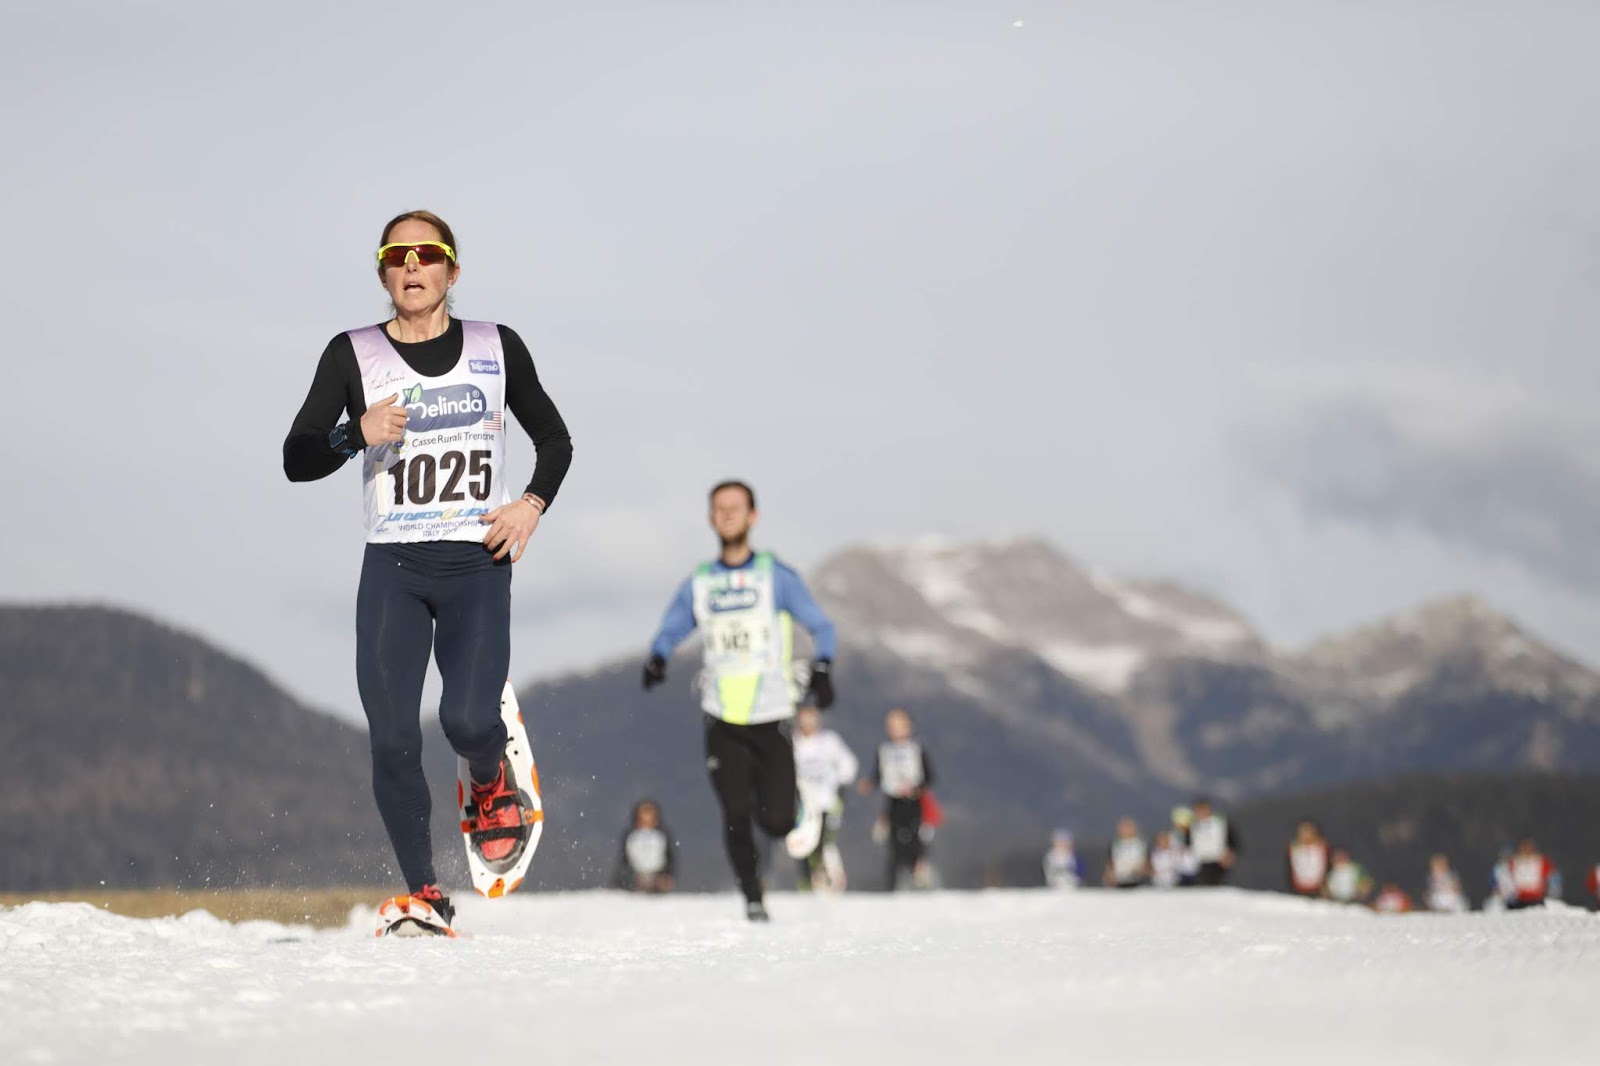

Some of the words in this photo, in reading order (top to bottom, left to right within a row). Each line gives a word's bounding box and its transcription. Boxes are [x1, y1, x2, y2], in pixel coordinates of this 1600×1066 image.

[411, 437, 437, 448] Casse
[437, 432, 463, 444] Rurali
[388, 450, 492, 506] 1025
[398, 522, 424, 532] WORLD
[422, 529, 441, 537] ITALY
